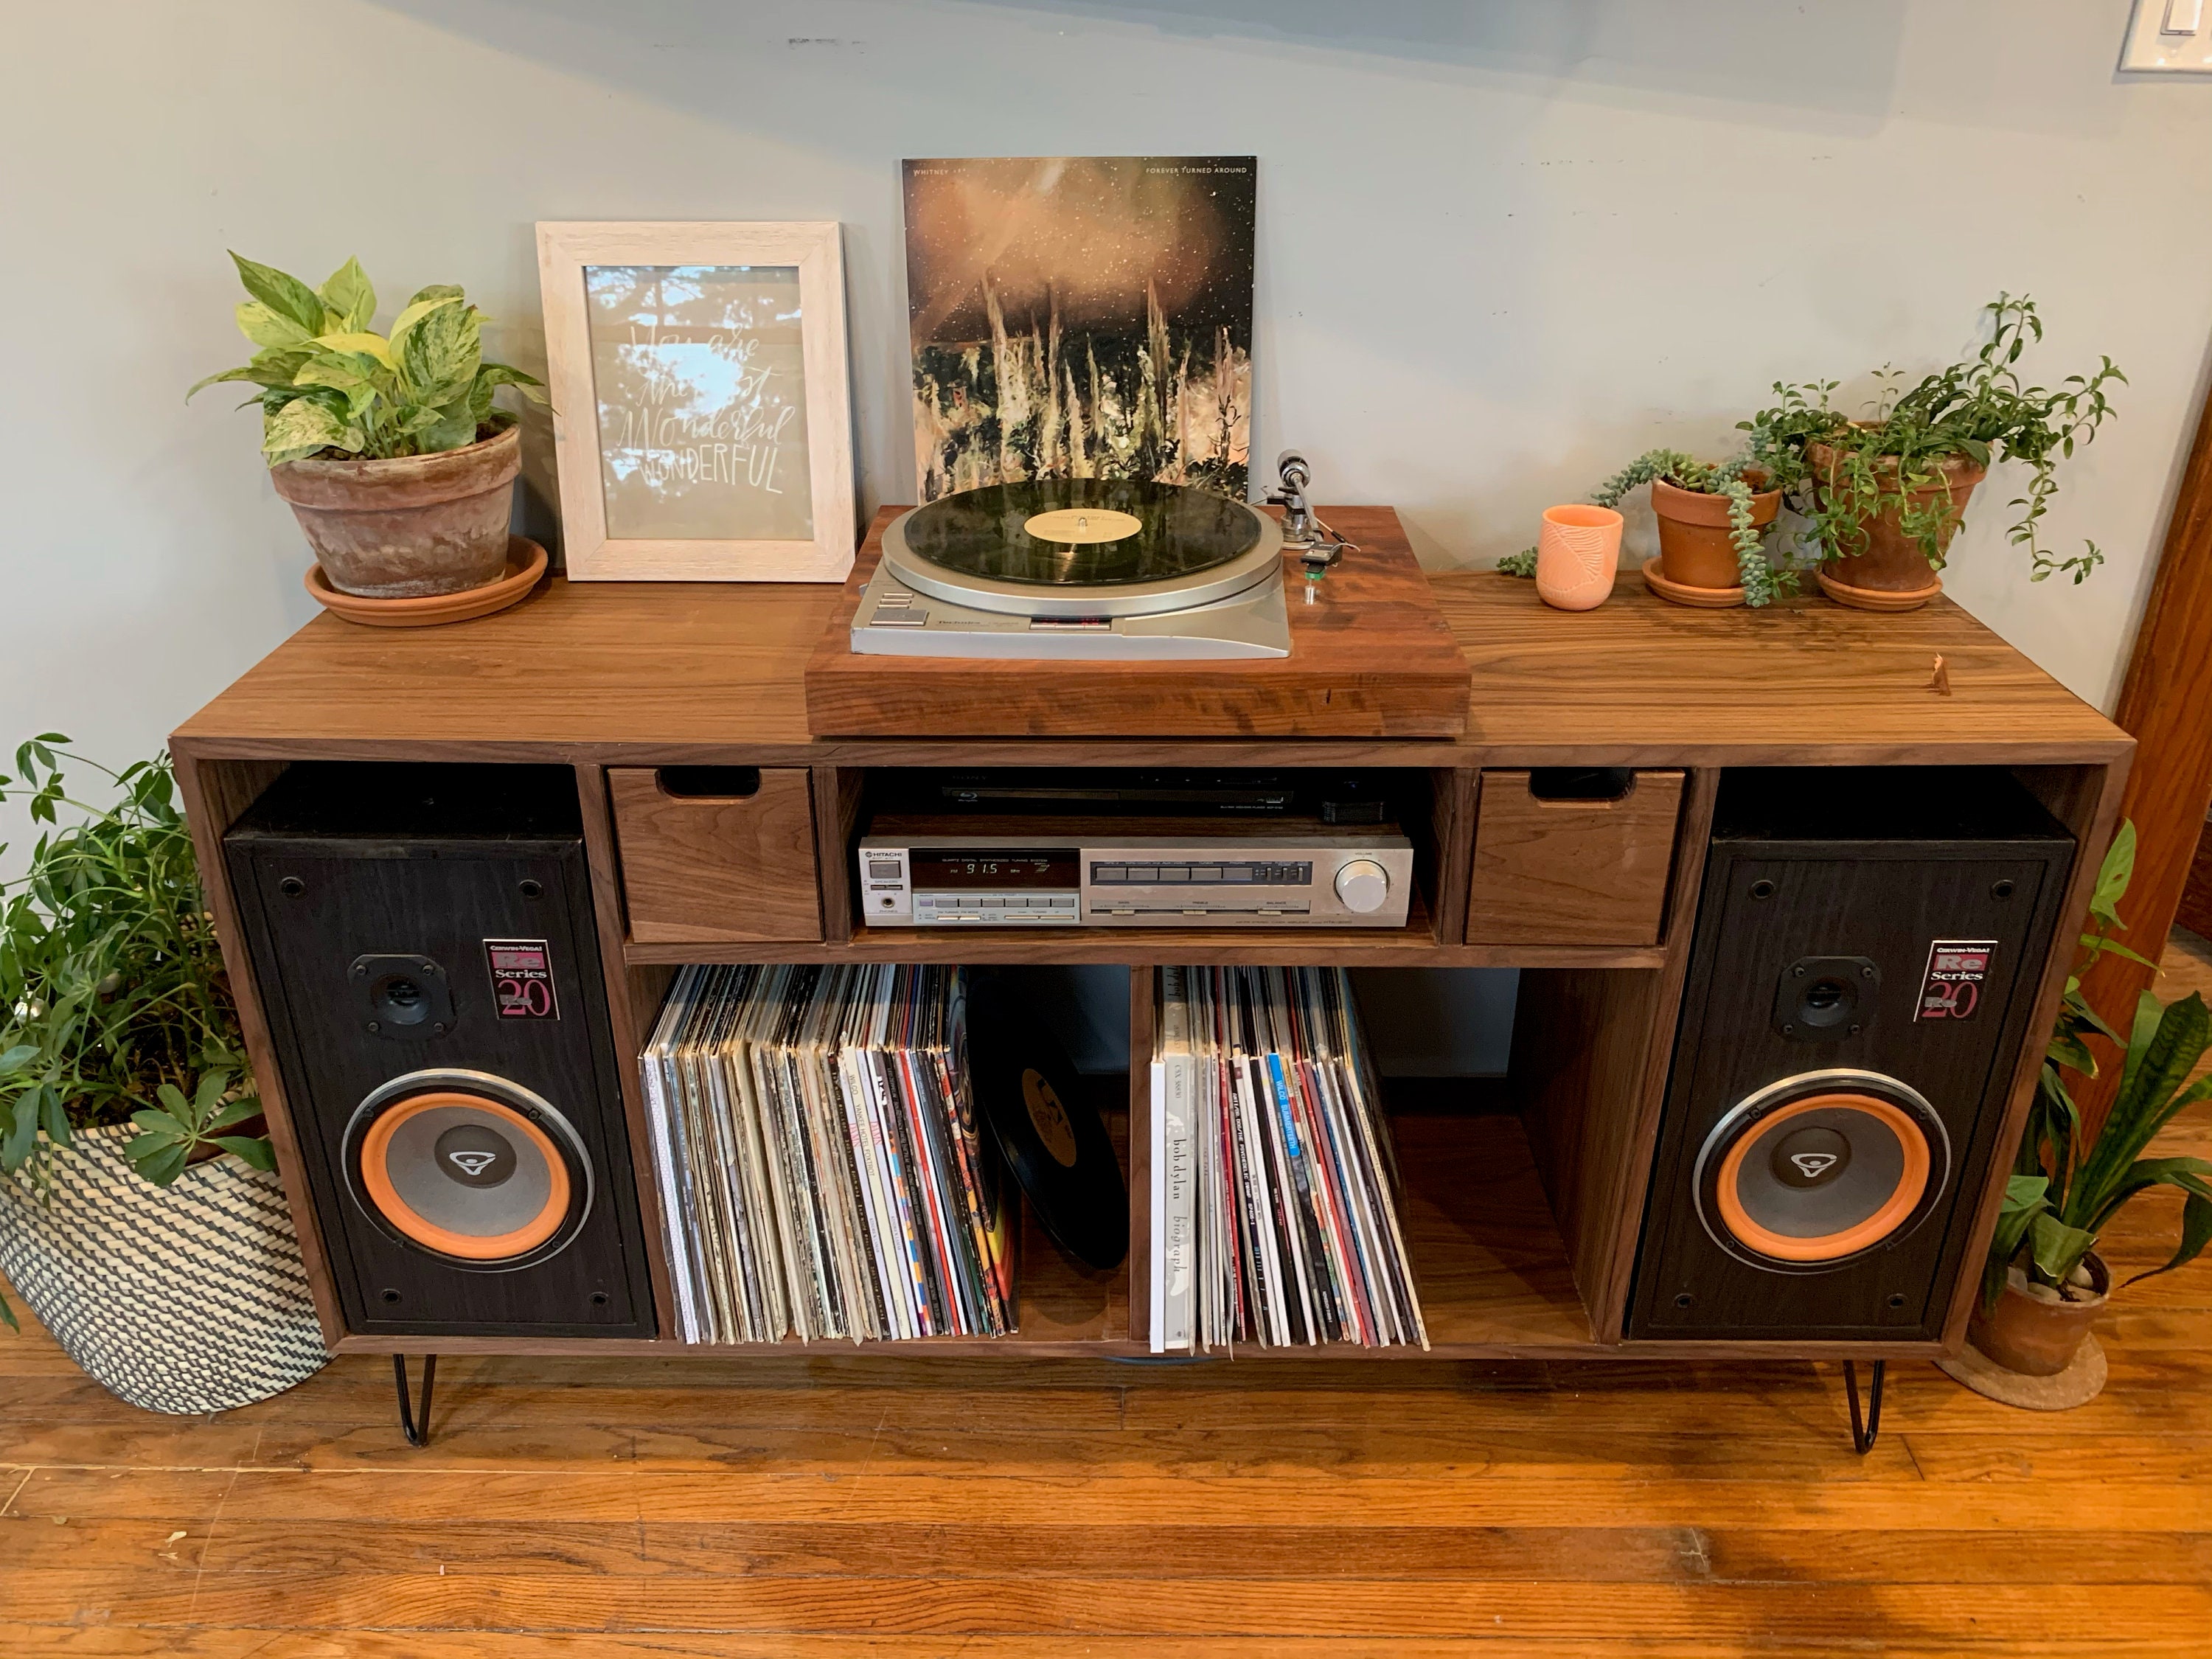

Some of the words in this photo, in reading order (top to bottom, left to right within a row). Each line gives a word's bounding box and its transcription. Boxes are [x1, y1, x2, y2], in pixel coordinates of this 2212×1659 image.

[639, 442, 783, 494] WONDERFUL
[497, 953, 540, 967] Re
[1936, 955, 1983, 970] Re
[495, 970, 548, 978] Series
[1930, 971, 1983, 980] Series
[498, 979, 551, 1017] 20
[1921, 981, 1978, 1018] 20
[849, 1074, 858, 1095] WILCO
[1275, 1079, 1286, 1100] WILCO
[855, 1104, 865, 1127] YANKEE
[1280, 1104, 1296, 1149] SUMMERTEETH
[860, 1128, 869, 1147] HOTEL
[1234, 1118, 1243, 1141] DOG/THE
[1239, 1144, 1249, 1179] PSYCHEDELIC
[1172, 1138, 1186, 1161] bob
[863, 1148, 874, 1176] FOXTROT
[1170, 1165, 1186, 1199] dylan
[1170, 1216, 1187, 1272] biograph
